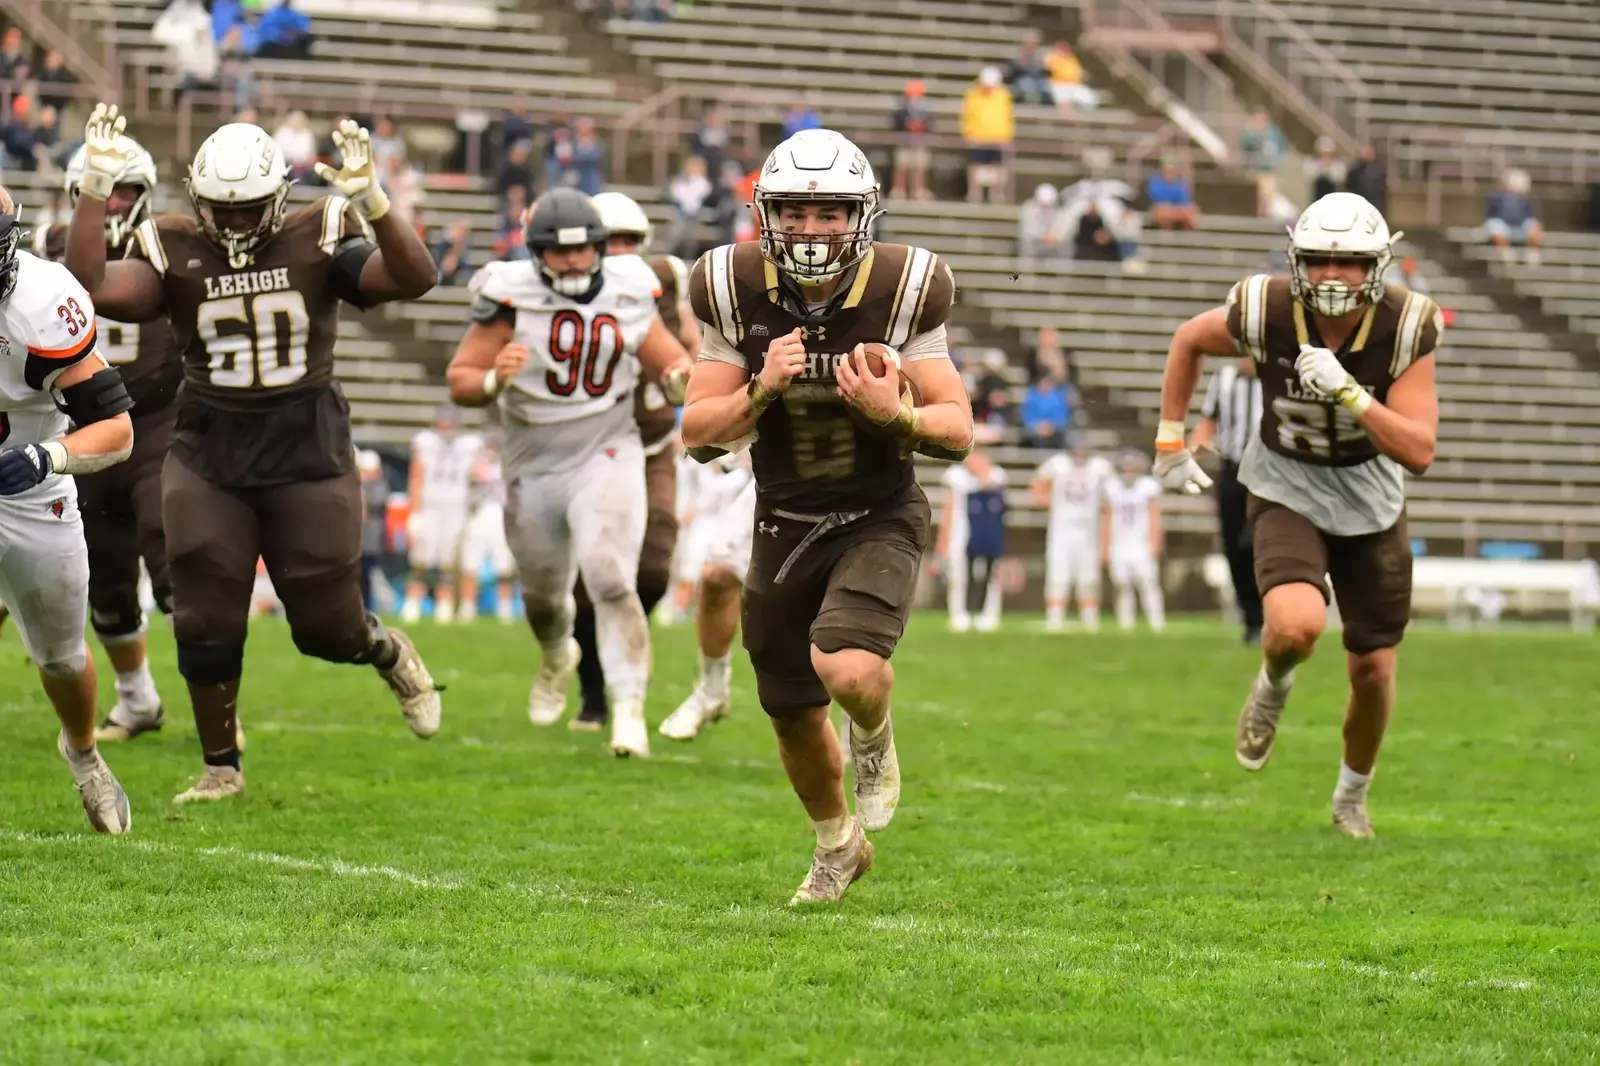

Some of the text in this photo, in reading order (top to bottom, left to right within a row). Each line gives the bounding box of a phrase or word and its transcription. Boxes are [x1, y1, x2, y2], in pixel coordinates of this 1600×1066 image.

[204, 267, 290, 299] LEHIGH
[57, 296, 88, 337] 33
[197, 290, 310, 388] 60
[545, 308, 624, 398] 90
